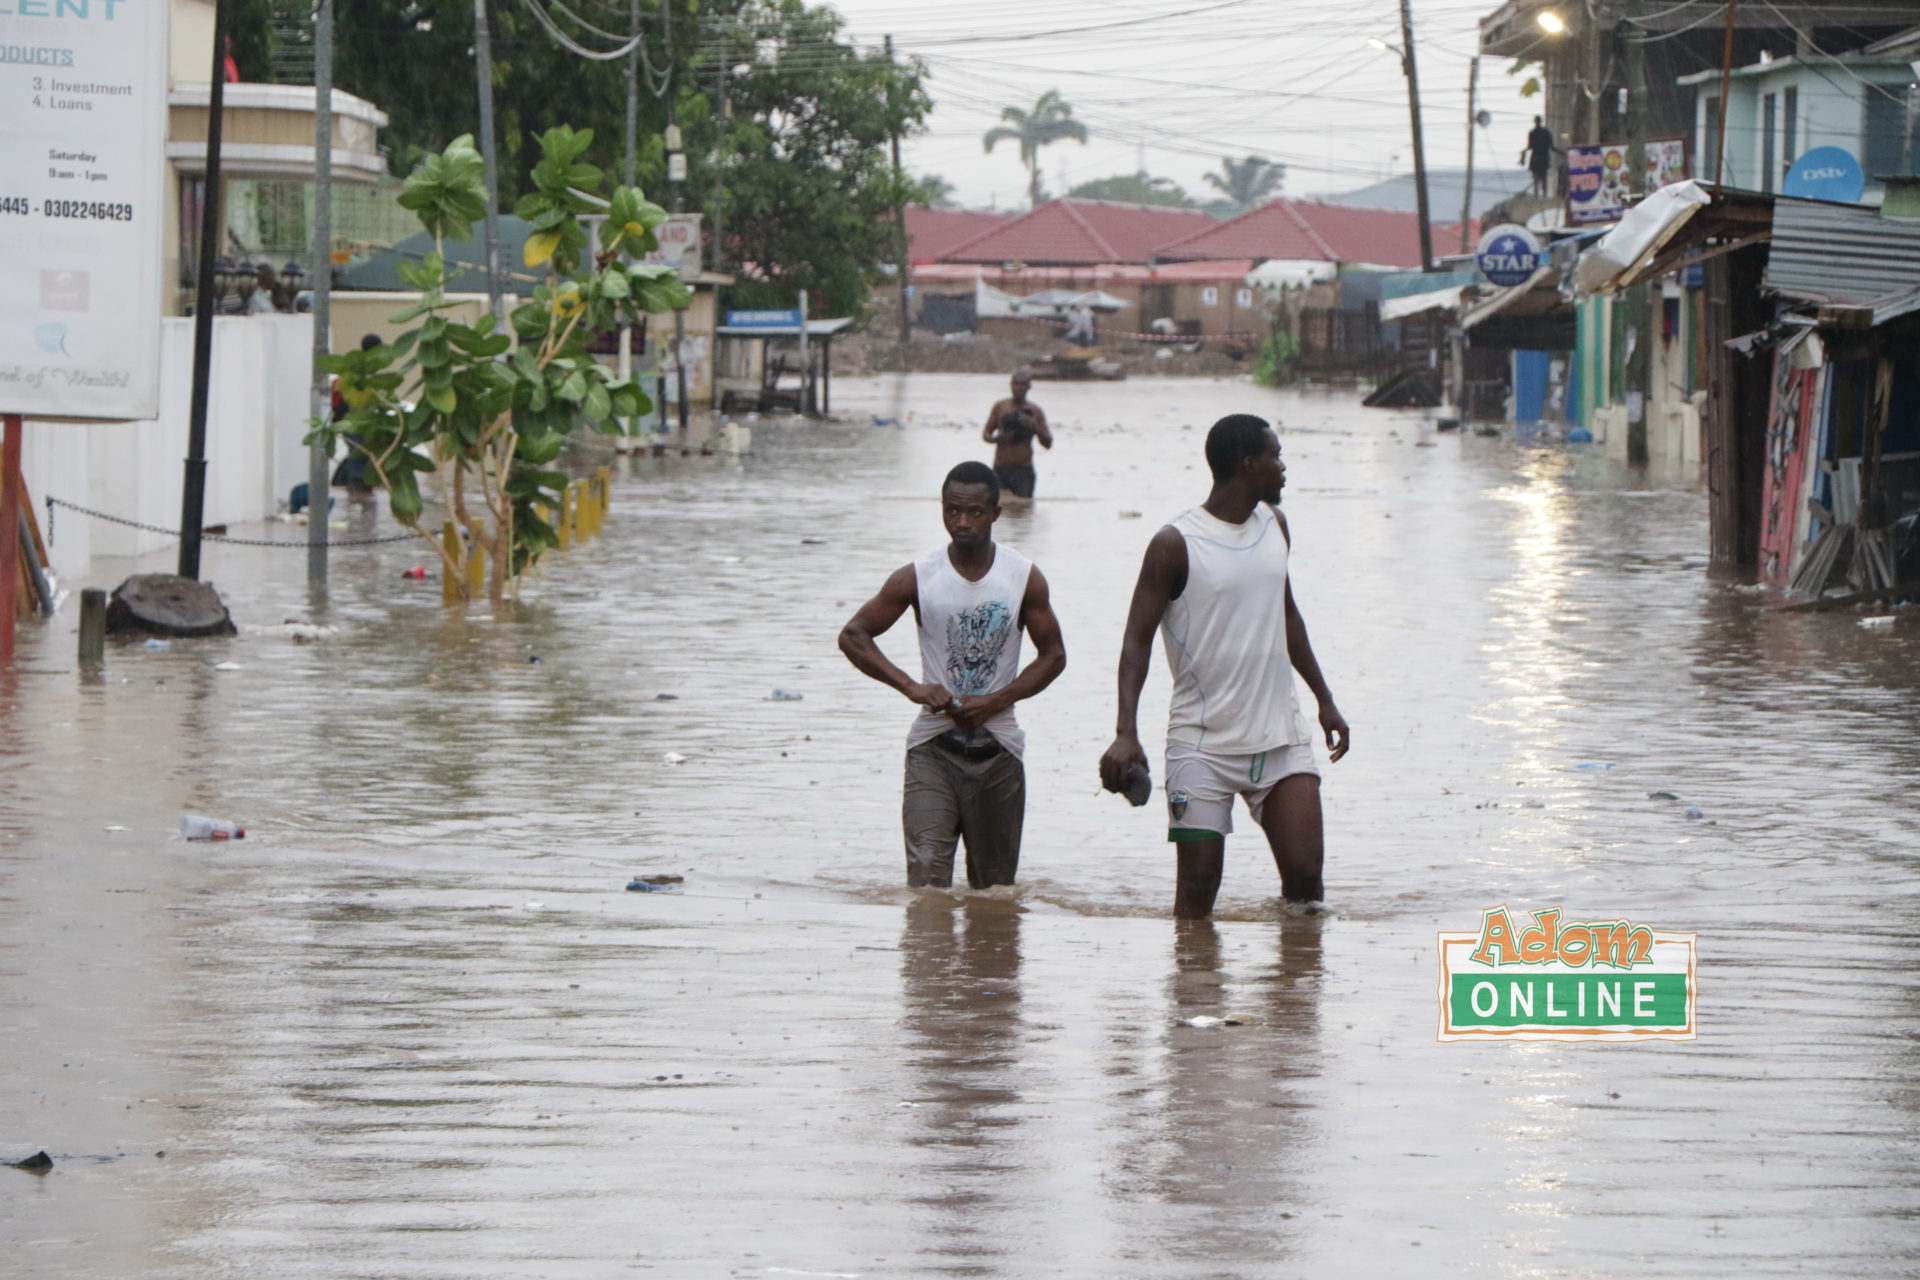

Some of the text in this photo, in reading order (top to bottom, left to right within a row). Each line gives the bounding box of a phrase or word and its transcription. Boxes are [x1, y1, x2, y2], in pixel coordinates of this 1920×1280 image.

[51, 78, 133, 96] Investment
[50, 96, 93, 111] Loans
[49, 149, 97, 163] Saturday
[44, 199, 133, 222] 0302246429
[1482, 254, 1535, 270] STAR
